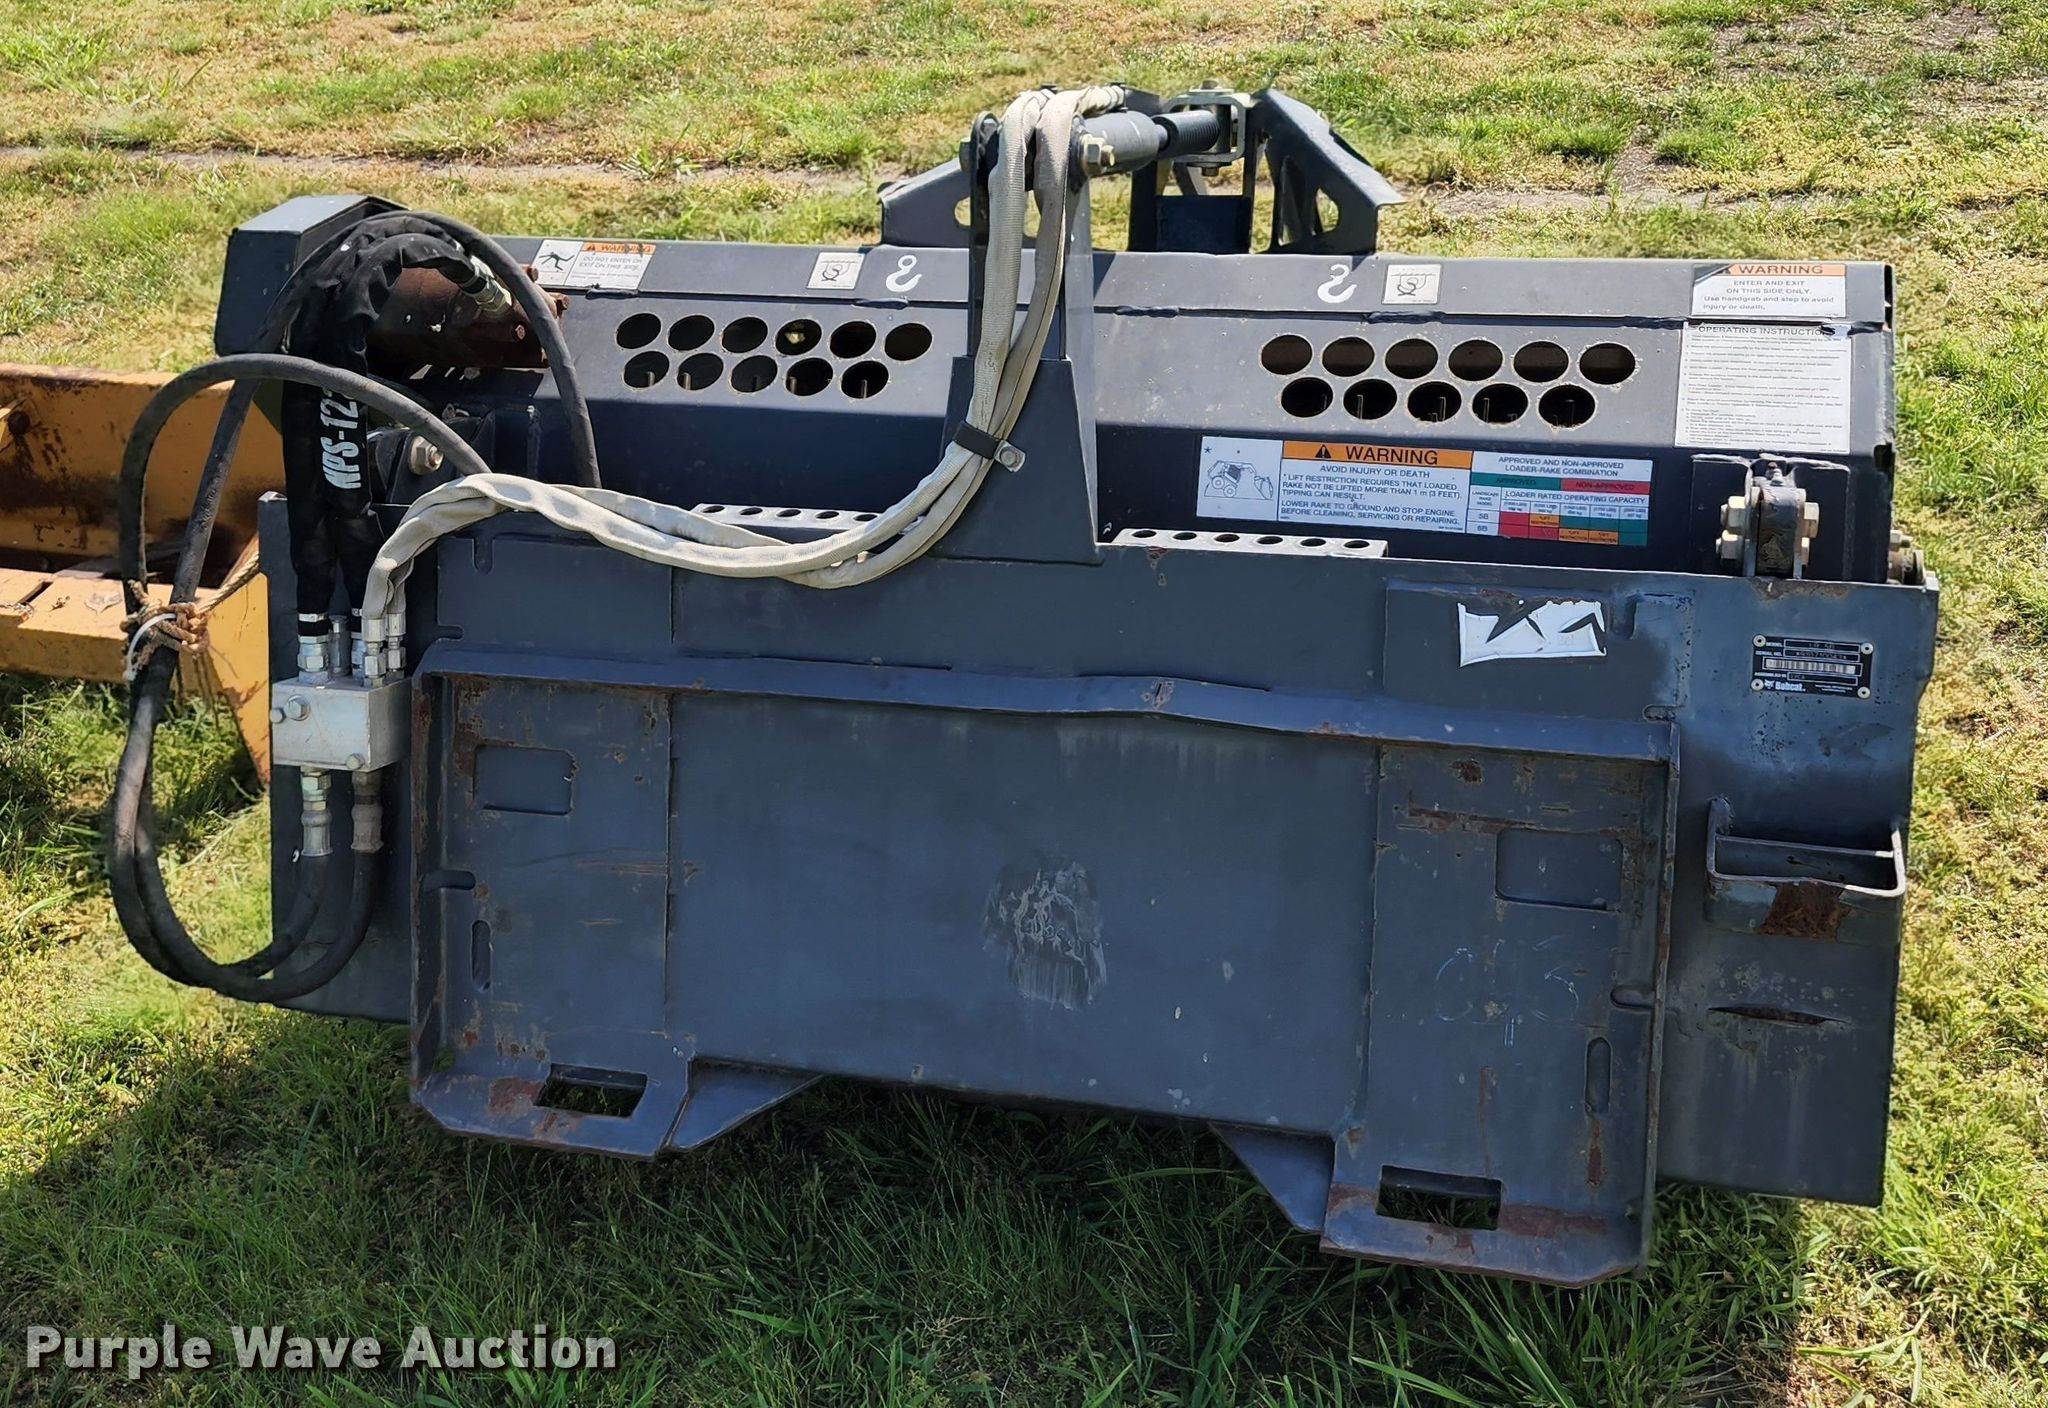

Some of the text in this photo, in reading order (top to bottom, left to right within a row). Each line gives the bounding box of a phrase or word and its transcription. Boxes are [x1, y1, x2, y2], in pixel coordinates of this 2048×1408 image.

[1738, 265, 1823, 274] WARNING
[1698, 326, 1835, 336] OPERATING INSTRUCTIO
[320, 386, 362, 489] NPS-12
[1345, 445, 1438, 465] WARNING
[1561, 459, 1624, 469] NON-APPROVED
[1320, 465, 1347, 473] AVOID
[1400, 470, 1430, 478] DEATH
[1505, 465, 1619, 476] LOADER-RAKE COMBINATION
[1306, 475, 1357, 483] RESTRICTION
[1360, 478, 1399, 487] REQUIRES
[1333, 492, 1365, 500] RESULT.
[1438, 491, 1462, 499] FEET).
[1505, 491, 1536, 499] LOADER
[1537, 492, 1562, 500] RATED
[1347, 503, 1381, 511] GROUND
[1425, 509, 1455, 517] ENGINE
[1358, 511, 1399, 521] SERVICING
[1415, 516, 1459, 525] REPAIRING.
[1775, 681, 1803, 691] Bobcat
